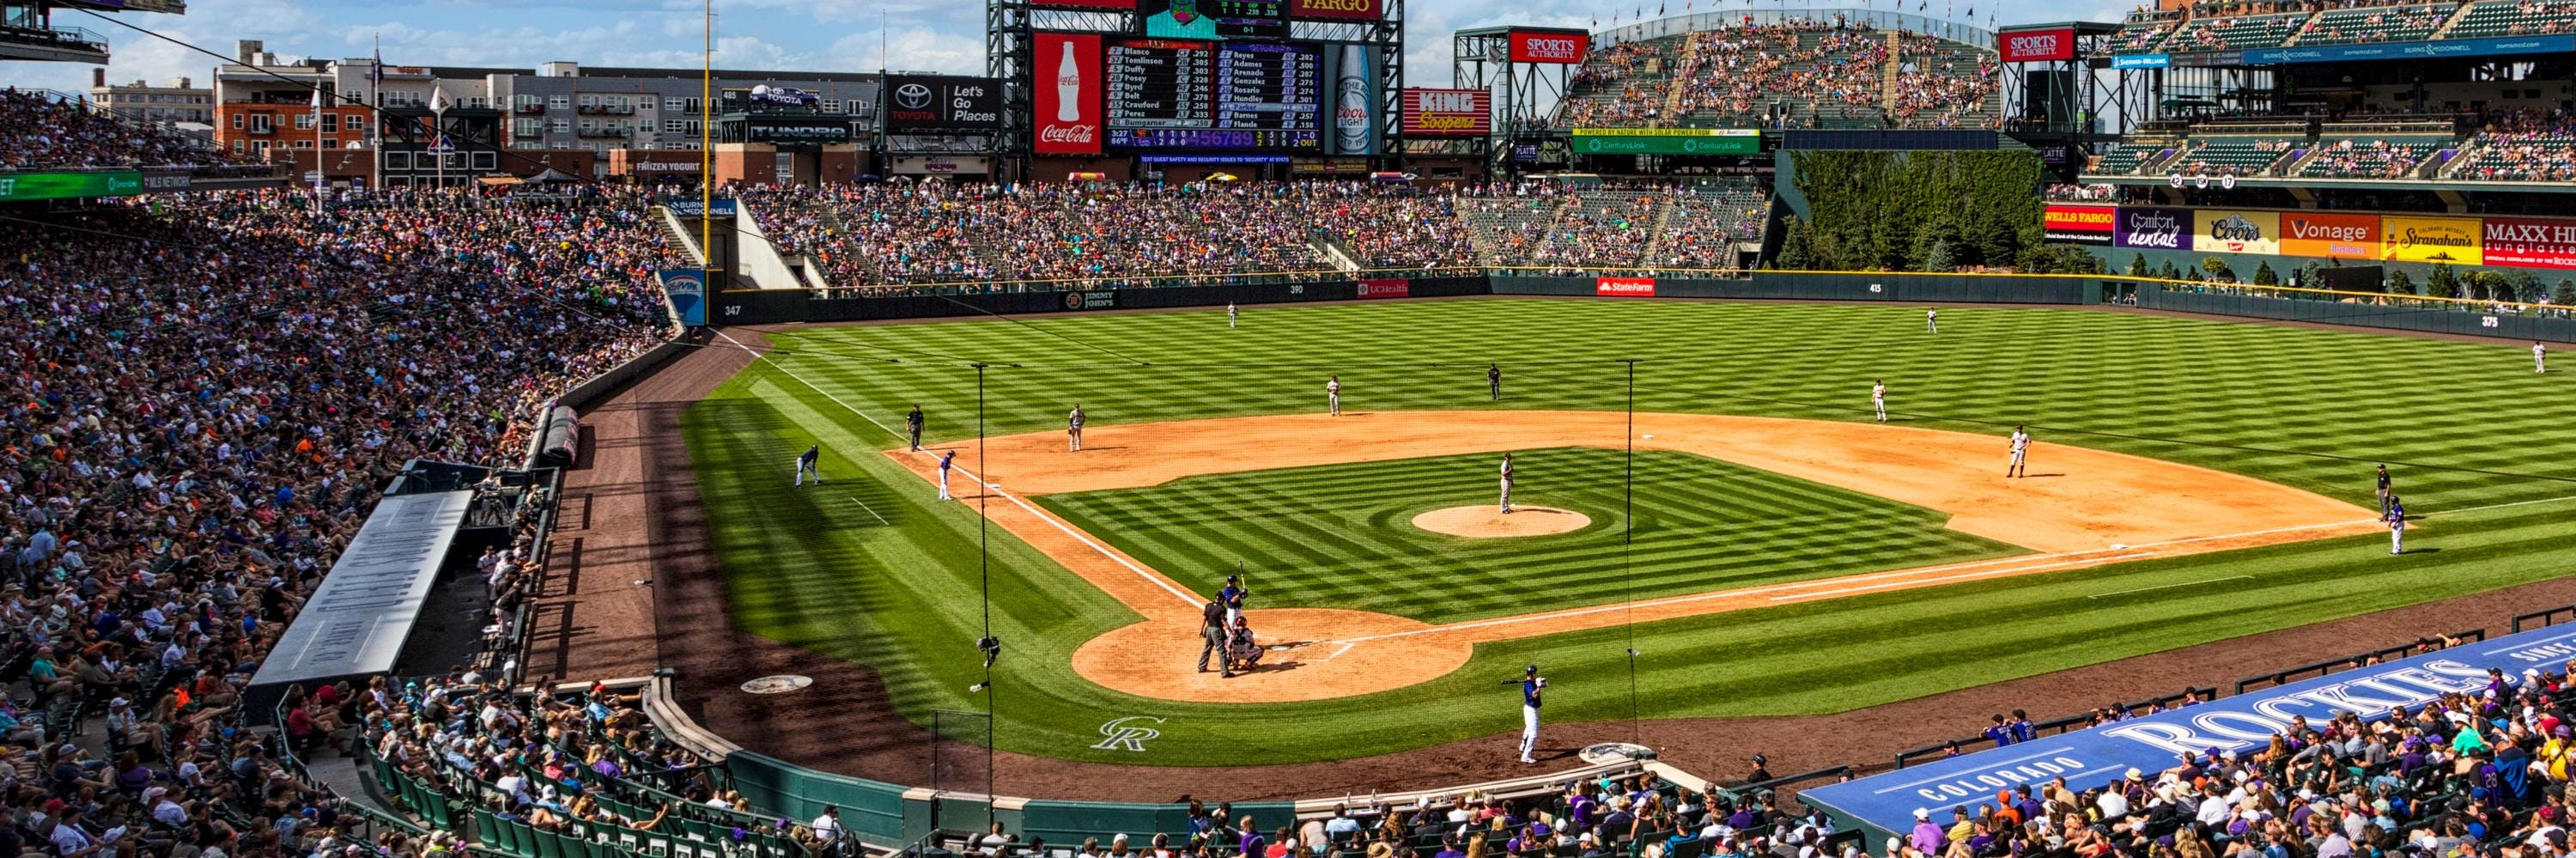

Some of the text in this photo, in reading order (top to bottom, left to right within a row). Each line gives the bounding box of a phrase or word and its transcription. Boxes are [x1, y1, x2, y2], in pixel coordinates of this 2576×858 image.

[1302, 0, 1369, 11] FARGO
[1527, 38, 1575, 52] SPORTS
[2011, 35, 2057, 49] SPORTS
[954, 85, 983, 97] Let's
[768, 94, 802, 106] TOYOTA
[954, 98, 971, 108] Go
[1419, 92, 1474, 112] KING
[892, 111, 935, 120] TOYOTA
[954, 111, 996, 121] Places
[1337, 103, 1367, 118] Coors
[1418, 111, 1476, 133] Soopers
[751, 127, 846, 137] TUNDRA
[1041, 124, 1096, 143] Coca-Cola
[1603, 142, 1646, 150] CenturyLink
[1699, 142, 1741, 150] CenturyLink
[669, 163, 700, 171] YOGURT
[150, 177, 162, 188] MLB
[163, 176, 190, 187] NETWORK
[2044, 212, 2112, 223] WELLS FARGO
[2211, 219, 2260, 242] Coors
[2485, 224, 2549, 242] MAXX
[2400, 227, 2472, 249] Stranahan's
[2331, 244, 2364, 254] Business
[668, 281, 698, 290] RE/MAX
[1291, 285, 1303, 294] 390
[1370, 284, 1408, 294] UCHealth
[1870, 283, 1881, 293] 415
[1085, 292, 1113, 300] JIMMY
[1085, 299, 1113, 308] JOHN'S
[725, 305, 741, 316] 347
[2482, 316, 2498, 327] 375
[317, 569, 422, 612] FIELD
[2100, 659, 2518, 760] ROCKIES
[1917, 757, 2085, 801] COLORADO
[2485, 773, 2497, 788] 28
